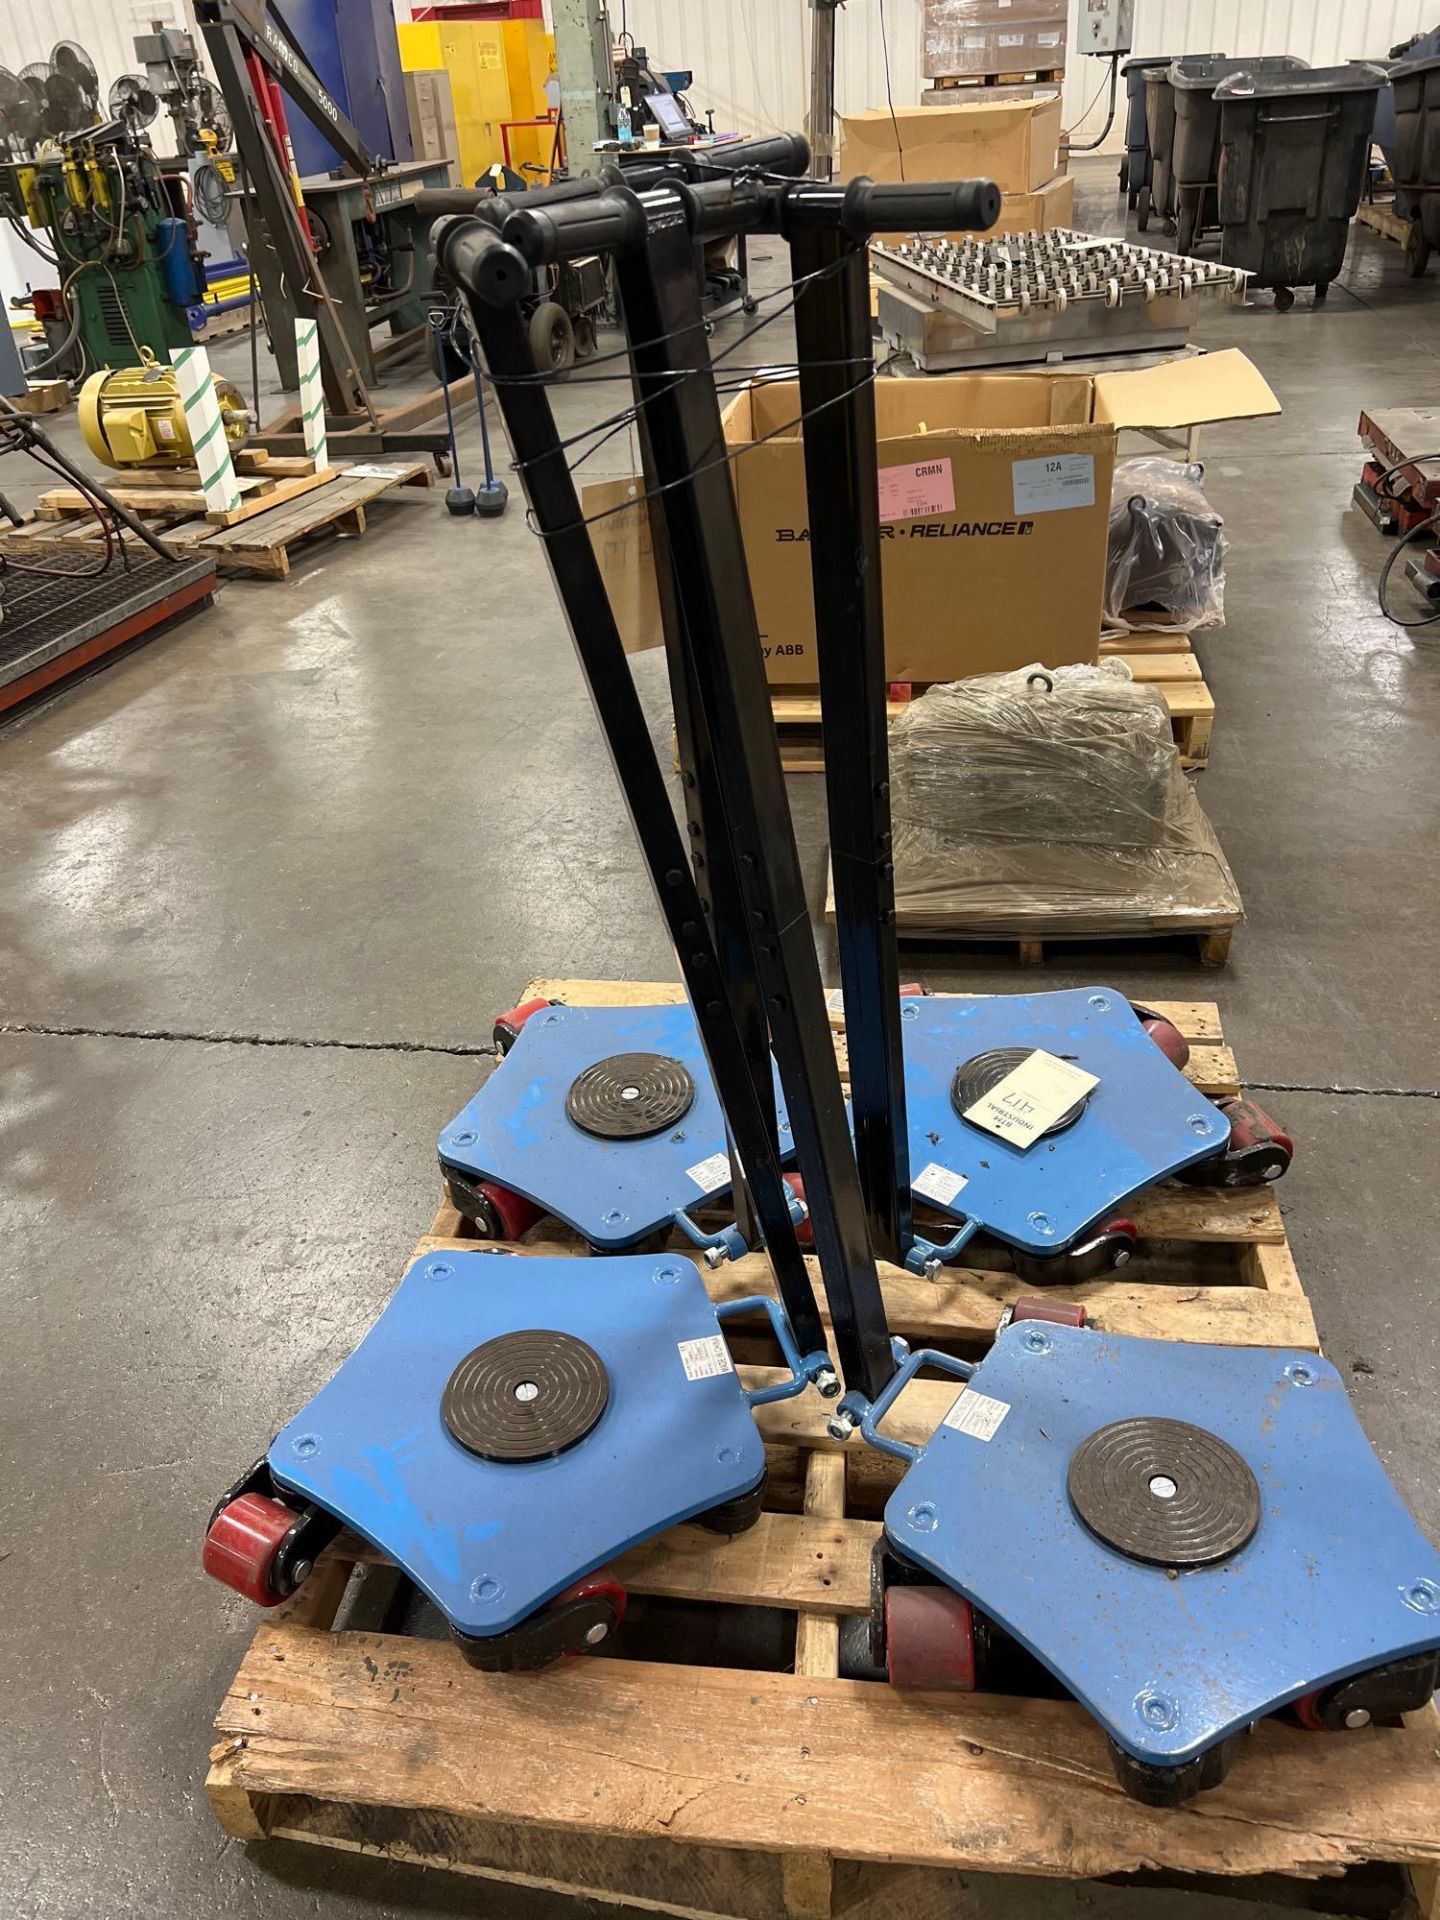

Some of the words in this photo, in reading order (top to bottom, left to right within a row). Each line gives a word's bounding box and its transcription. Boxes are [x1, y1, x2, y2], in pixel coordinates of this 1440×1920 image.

[318, 88, 338, 122] 5000
[915, 464, 943, 477] CRMN
[1045, 461, 1062, 472] 12A
[910, 521, 1018, 538] RELIANCE
[775, 644, 804, 656] ABB
[1002, 1092, 1035, 1113] 417
[987, 1102, 1034, 1130] INDUSTRIAL
[994, 1115, 1013, 1128] BTM
